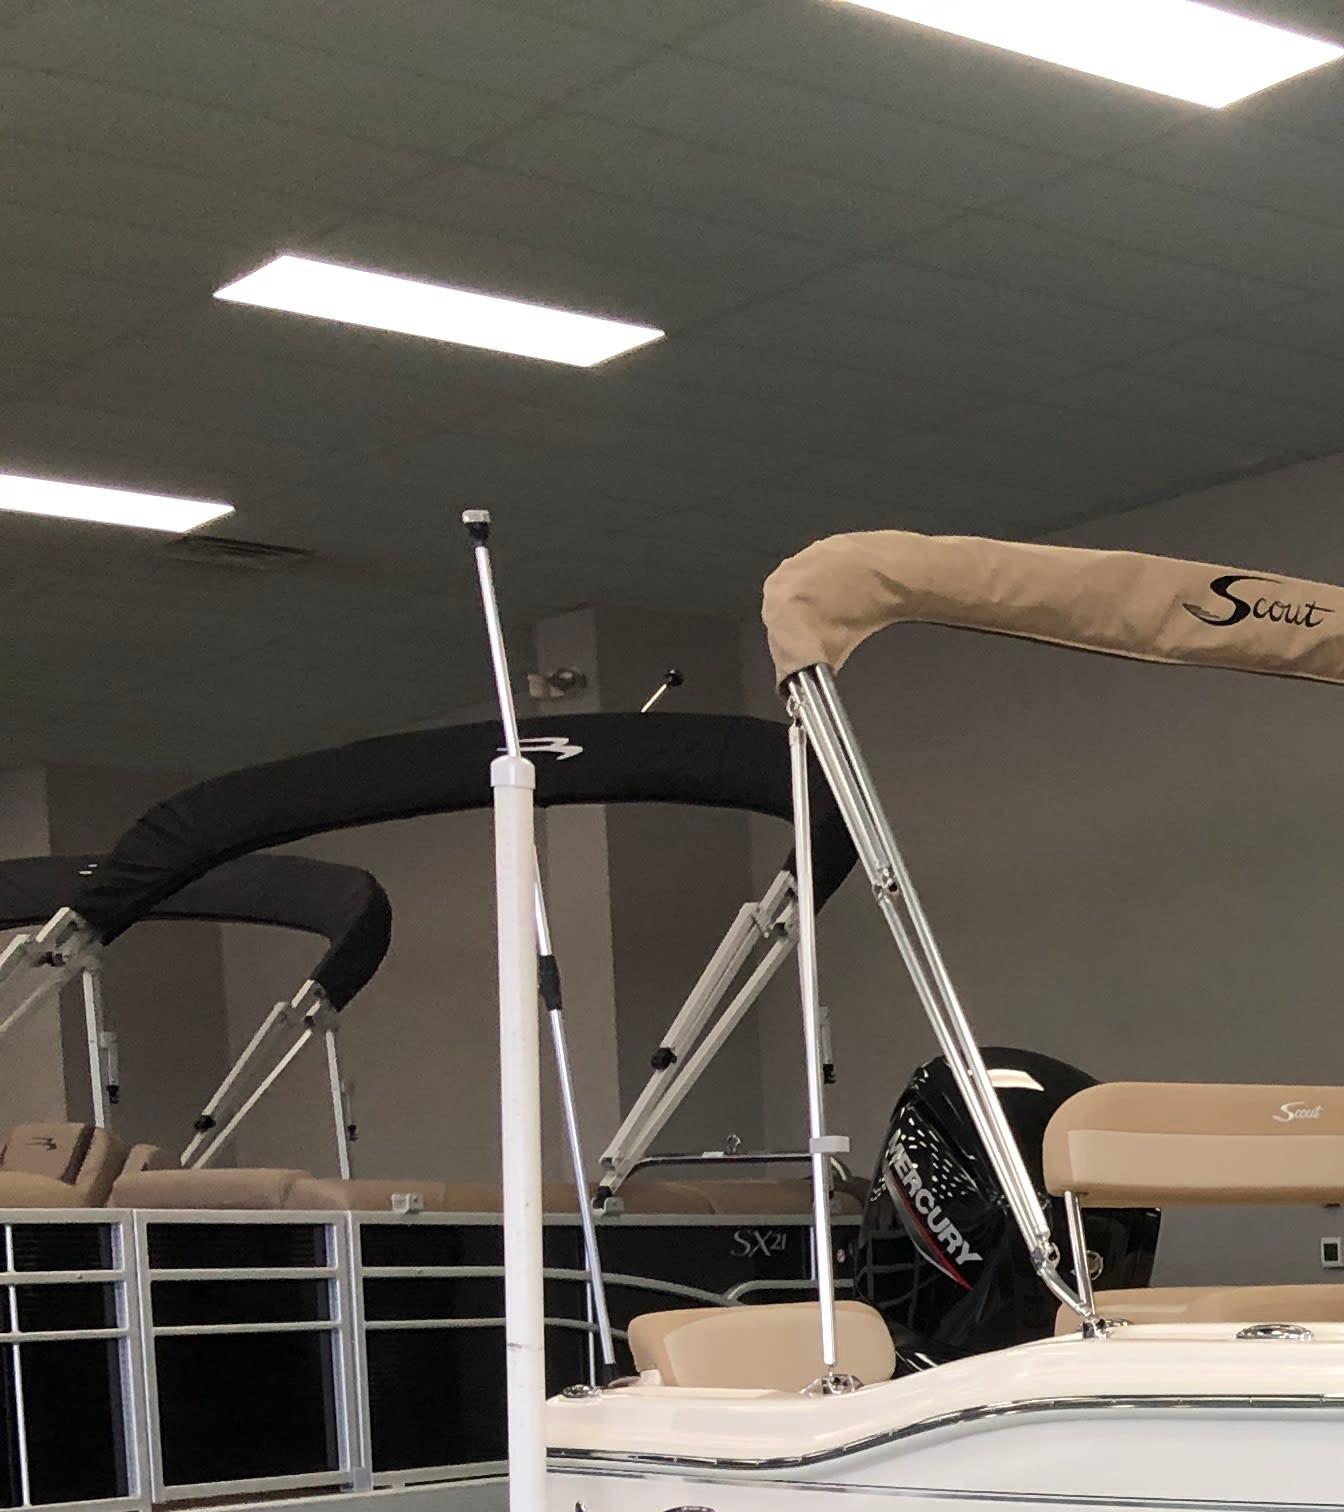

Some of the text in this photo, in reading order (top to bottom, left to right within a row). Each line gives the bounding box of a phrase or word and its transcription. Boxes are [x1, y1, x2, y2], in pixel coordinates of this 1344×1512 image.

[1182, 576, 1335, 628] Scout
[1272, 1101, 1325, 1123] Scout
[885, 1128, 984, 1266] MERCURY
